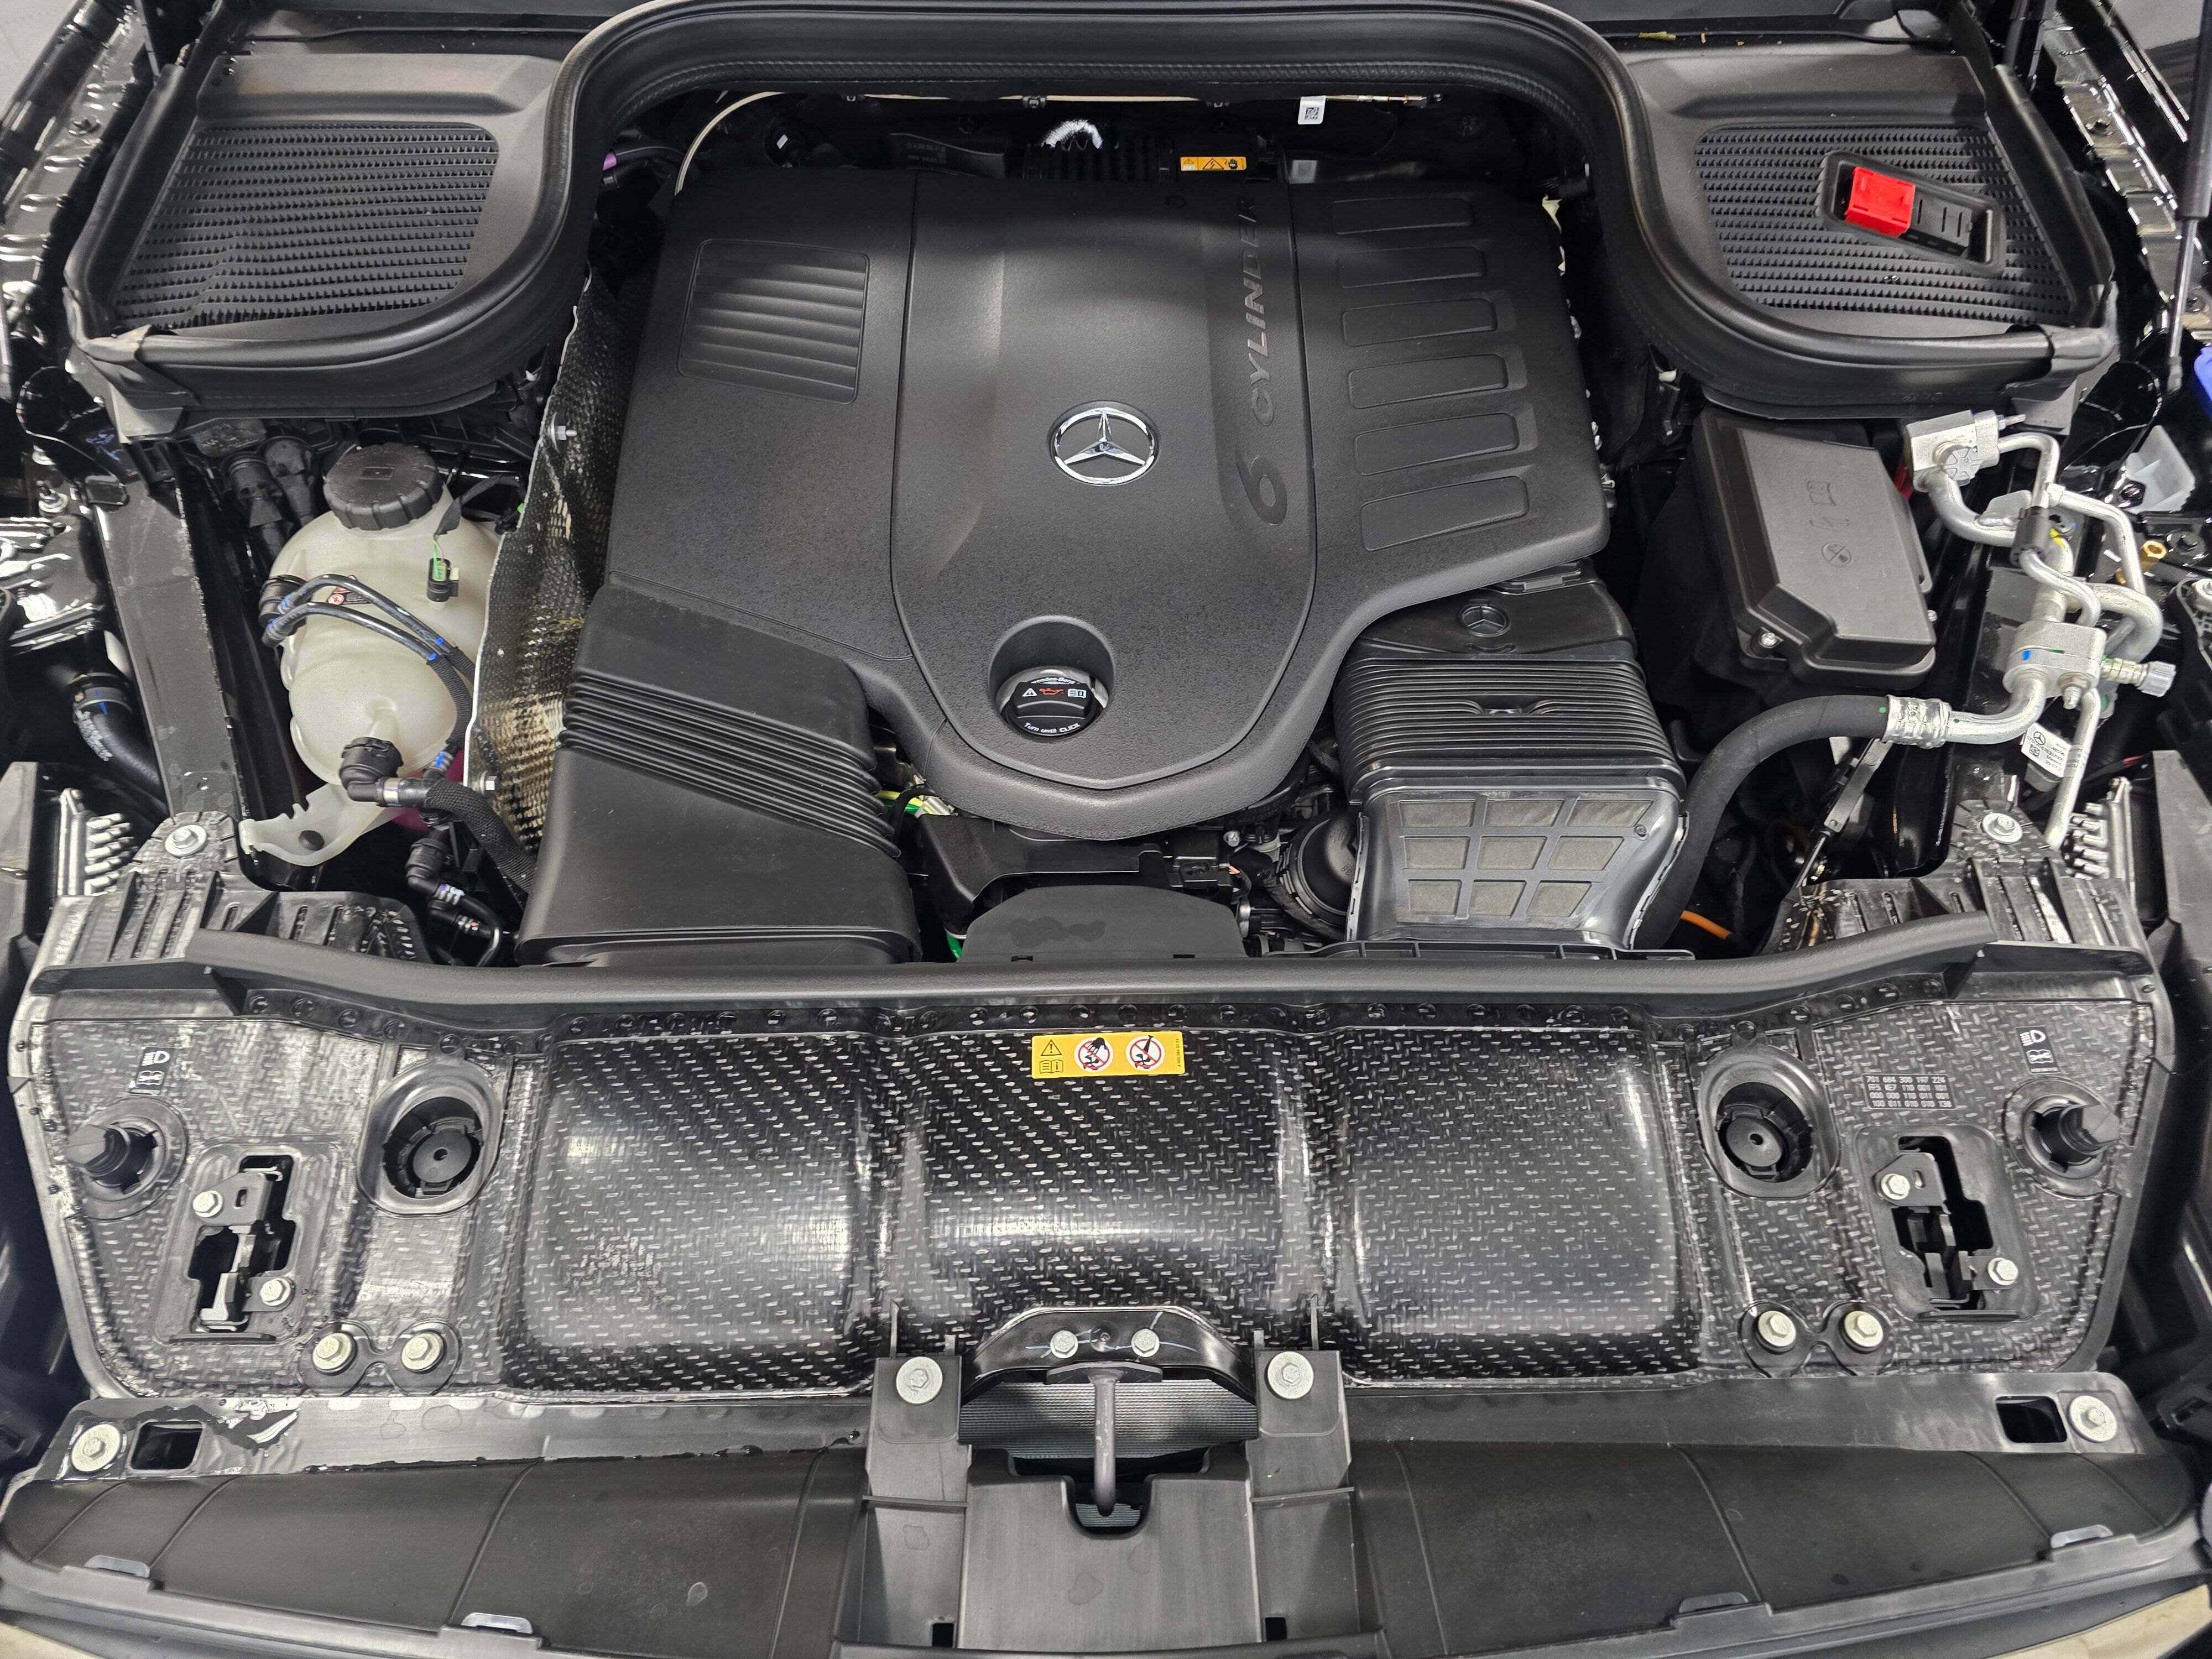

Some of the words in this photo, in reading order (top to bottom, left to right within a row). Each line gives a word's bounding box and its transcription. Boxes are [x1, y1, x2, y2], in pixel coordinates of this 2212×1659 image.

[1237, 195, 1275, 427] CYLINDER
[1235, 444, 1287, 526] 6
[1024, 722, 1040, 732] Turn
[1059, 722, 1082, 733] CLICK
